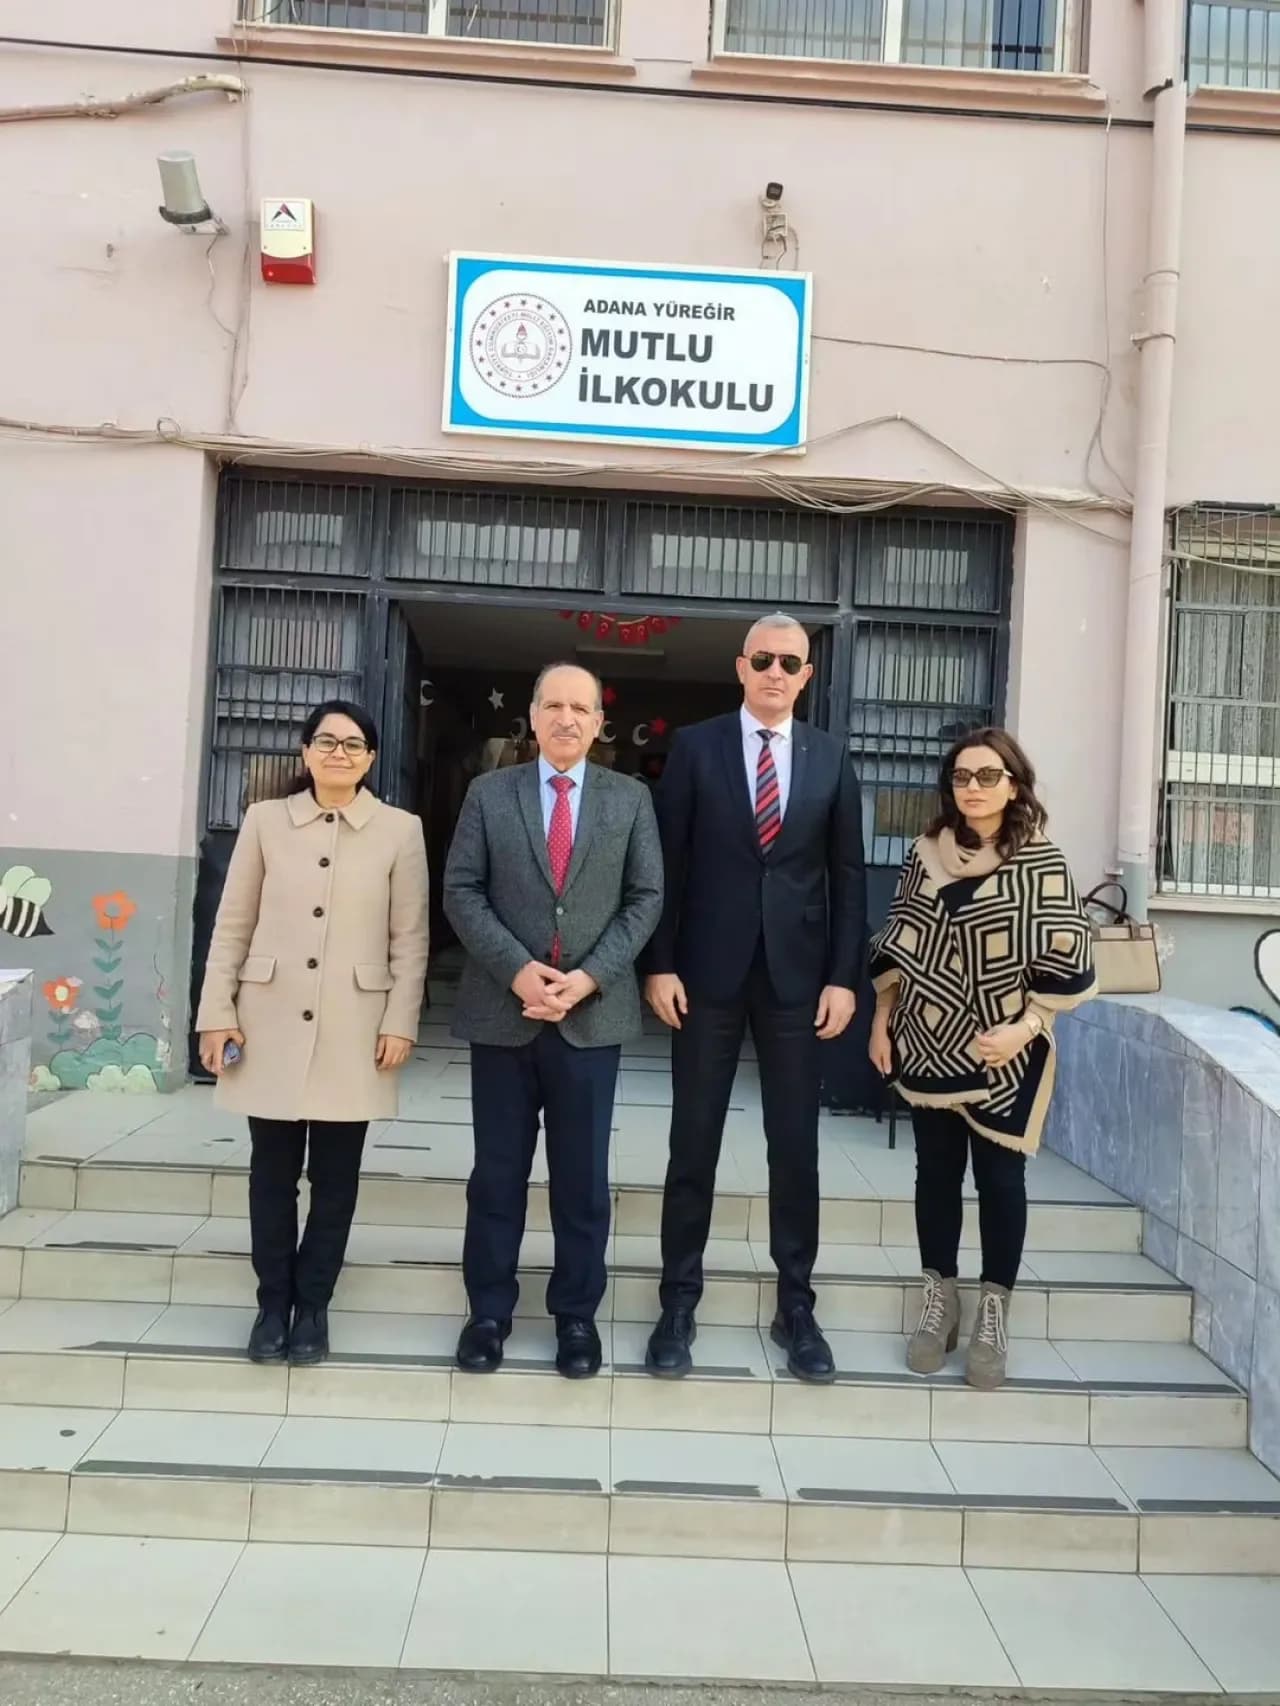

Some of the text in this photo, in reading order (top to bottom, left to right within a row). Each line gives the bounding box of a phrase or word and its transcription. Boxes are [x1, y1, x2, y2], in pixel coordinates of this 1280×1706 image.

[584, 298, 735, 321] ADANA YÜREĞİR
[581, 328, 713, 363] MUTLU
[579, 366, 774, 412] İLKOKULU
